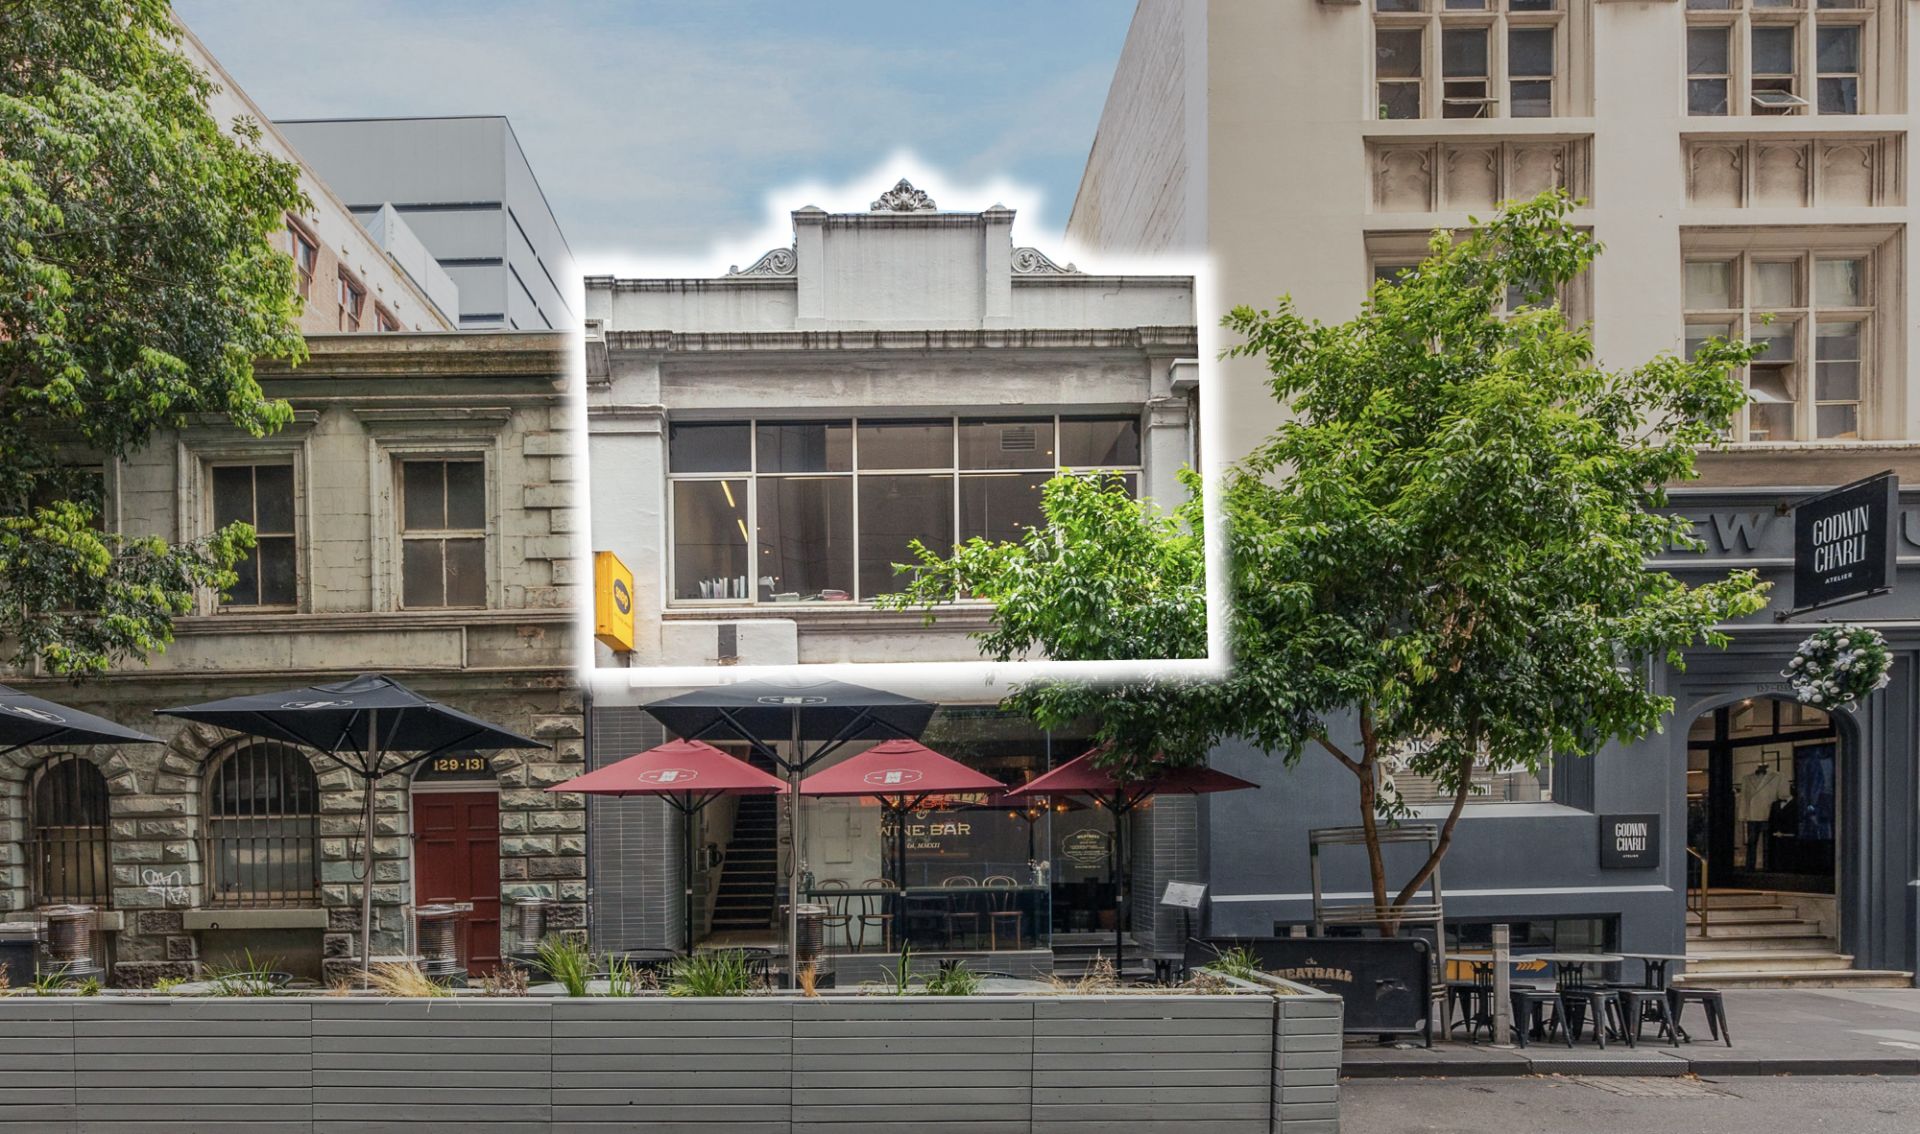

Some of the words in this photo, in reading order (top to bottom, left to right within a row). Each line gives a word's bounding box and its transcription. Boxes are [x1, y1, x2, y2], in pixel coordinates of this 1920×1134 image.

[1812, 504, 1869, 546] GODWIN
[1814, 534, 1866, 573] CHARLI
[1824, 572, 1853, 584] ATELIER
[930, 822, 972, 837] BAR
[1615, 823, 1647, 837] GODWIN
[1616, 837, 1646, 851] CHARLI
